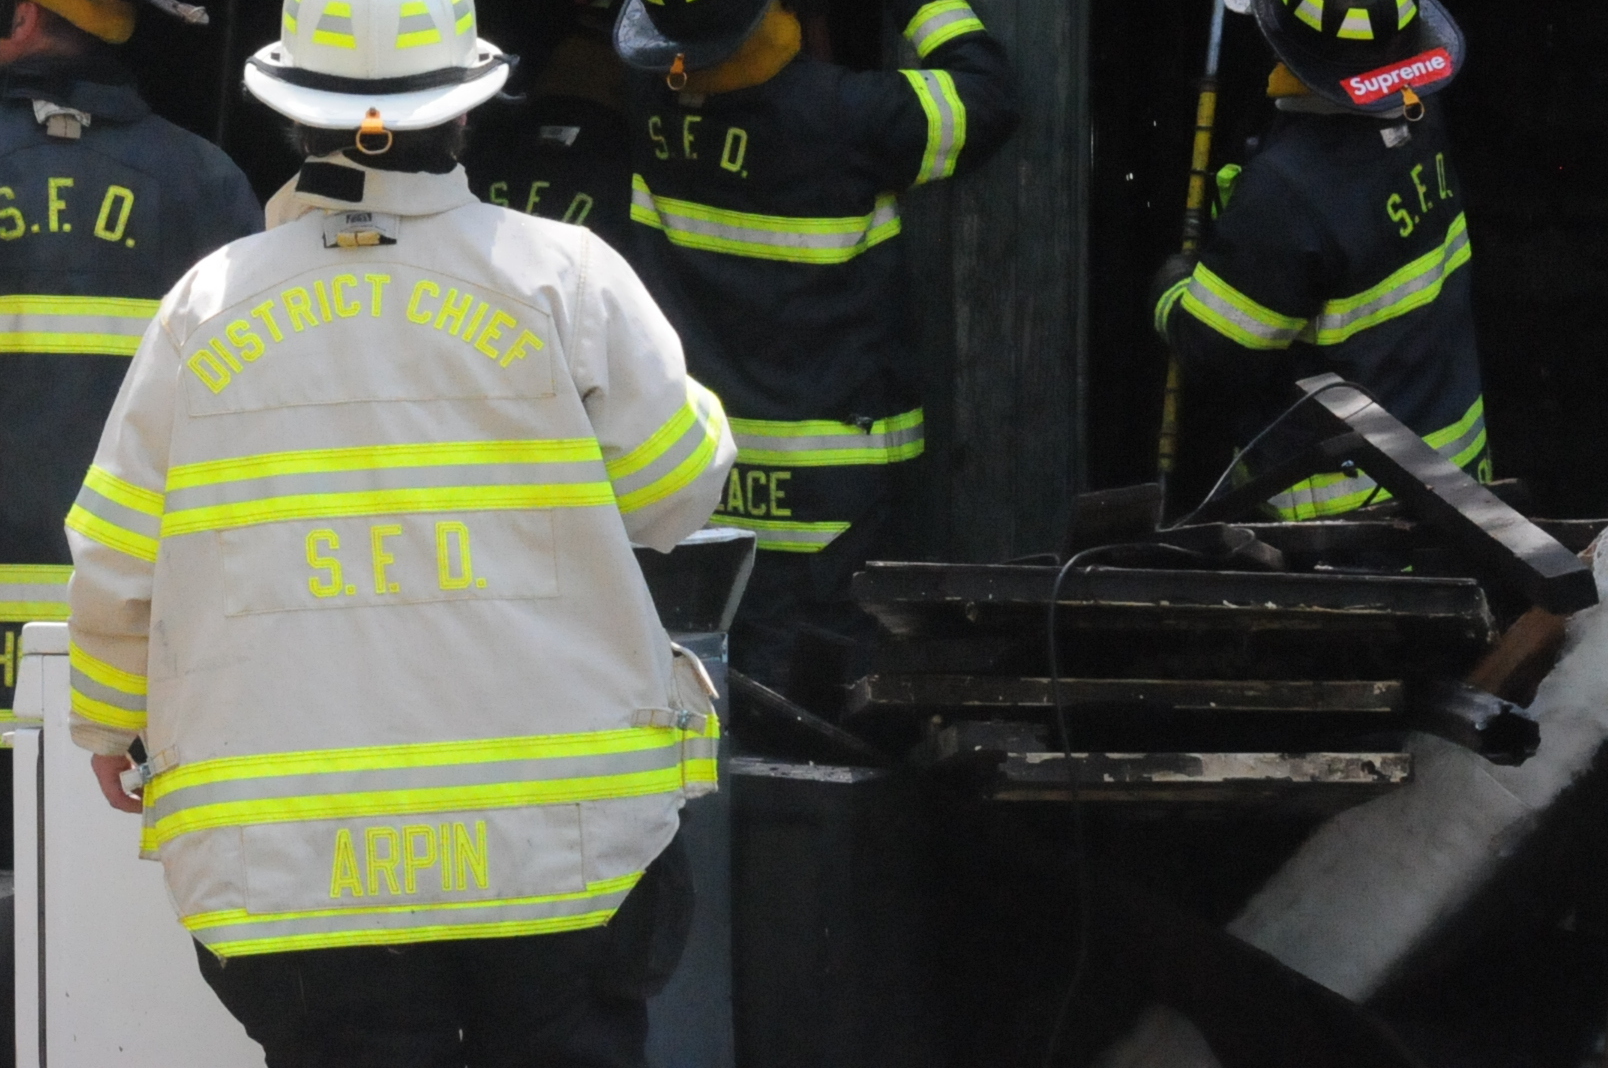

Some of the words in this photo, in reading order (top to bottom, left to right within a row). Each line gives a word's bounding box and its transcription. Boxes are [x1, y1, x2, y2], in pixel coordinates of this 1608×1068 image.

[1349, 55, 1446, 96] Supreme
[187, 273, 391, 395] DISTRICT
[405, 279, 544, 369] CHIEF
[714, 467, 792, 517] ACE
[329, 820, 490, 899] ARPIN
